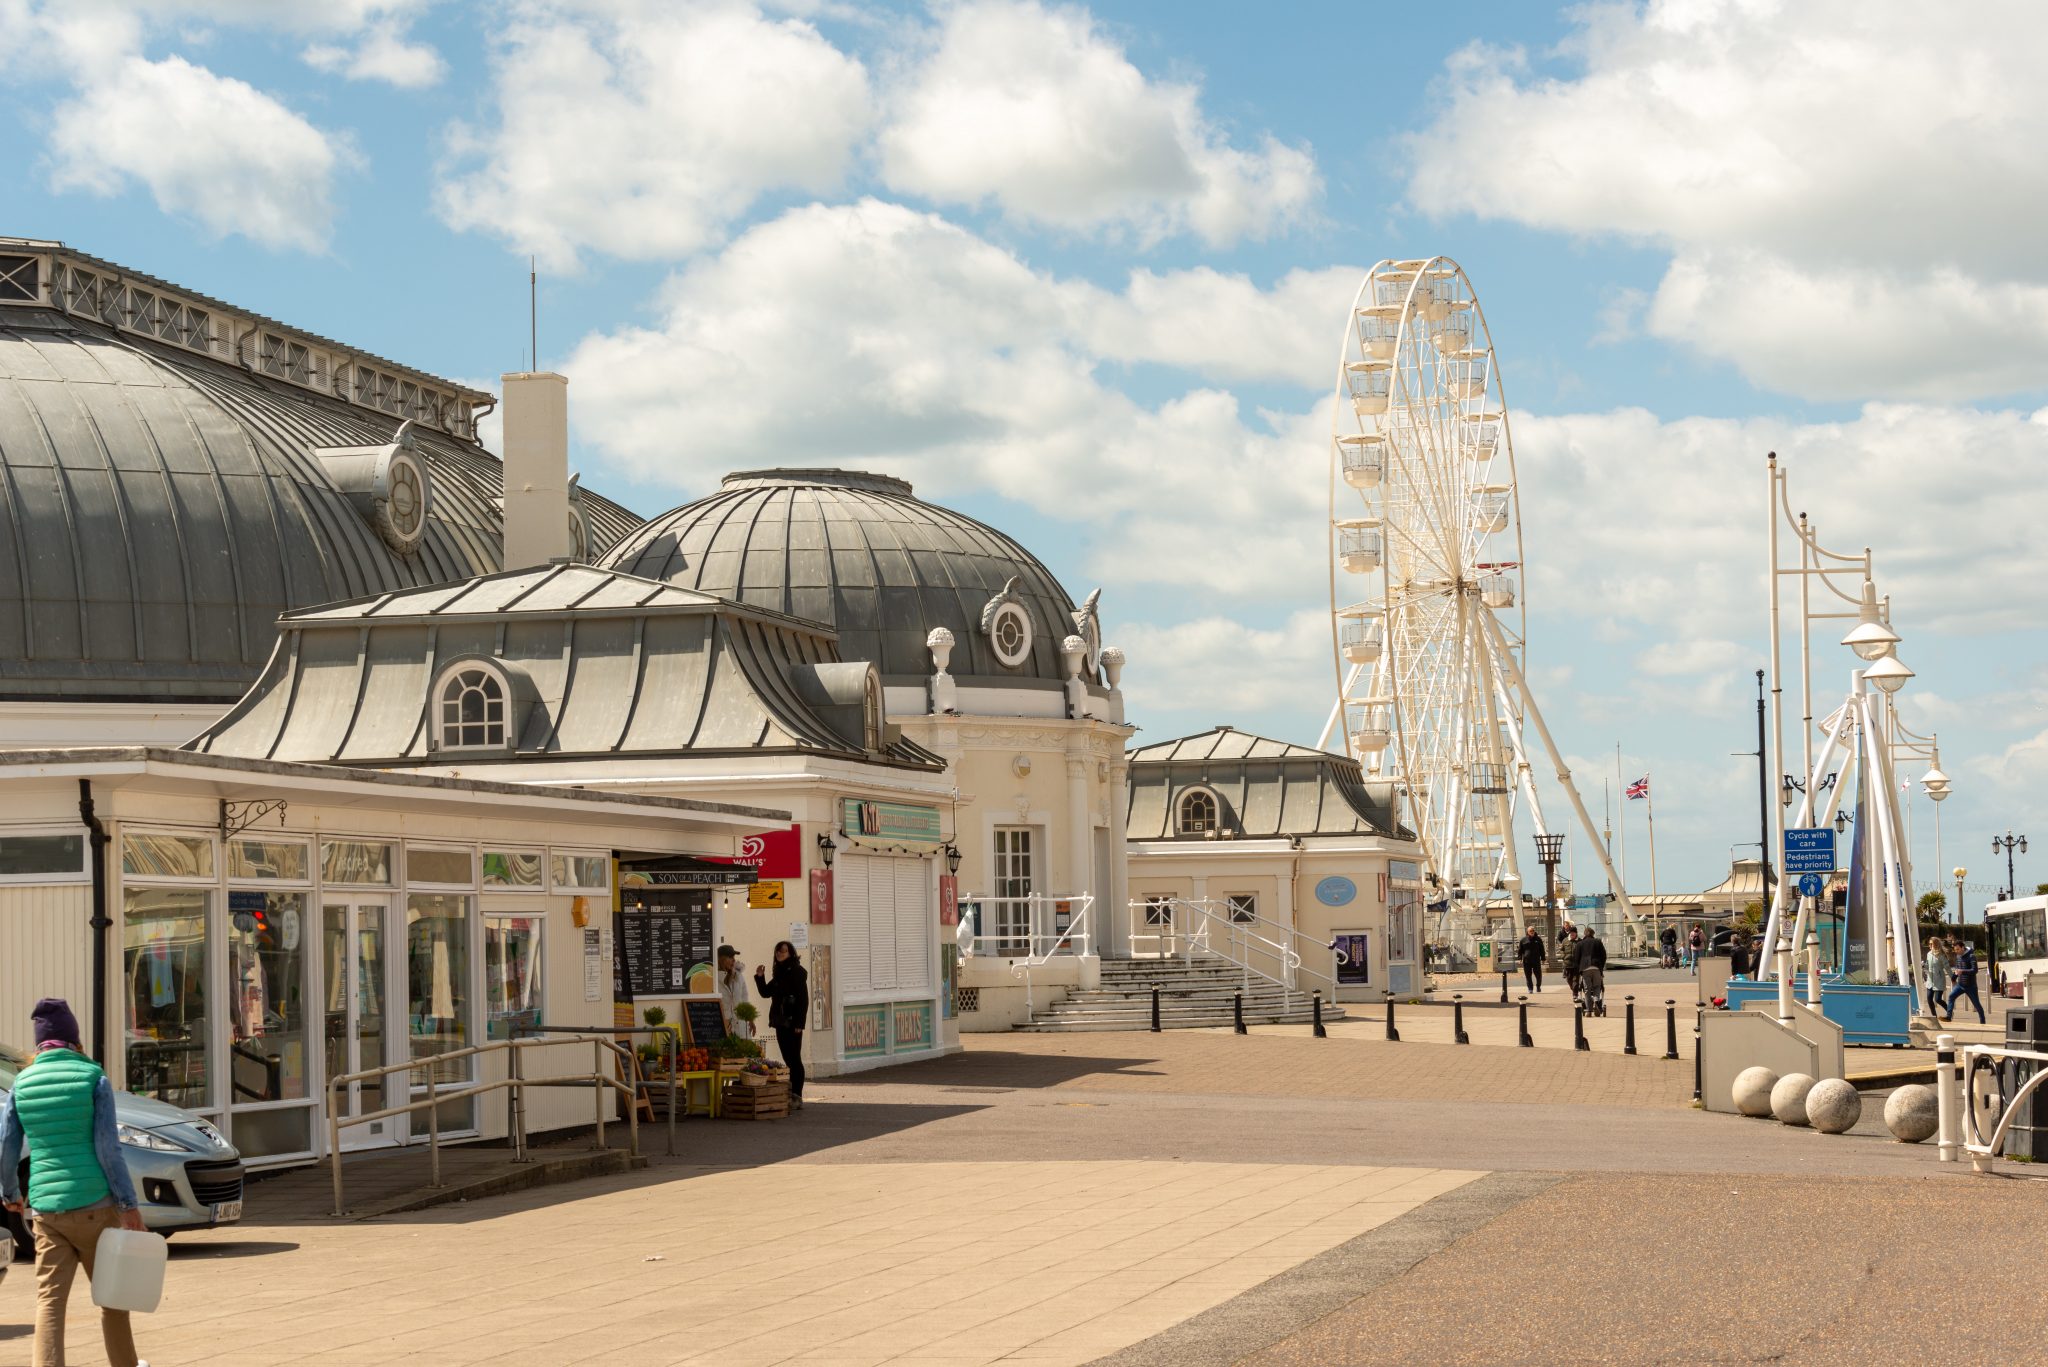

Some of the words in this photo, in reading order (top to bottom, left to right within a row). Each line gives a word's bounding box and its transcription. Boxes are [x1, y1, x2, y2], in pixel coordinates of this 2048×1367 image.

[1788, 832, 1809, 840] Cycle
[1811, 831, 1827, 839] with
[1804, 861, 1832, 869] priority
[658, 874, 679, 884] SON
[692, 874, 722, 884] PEACH
[845, 1015, 857, 1047] ICE
[857, 1012, 879, 1046] CREAM
[896, 1009, 922, 1041] TREATS
